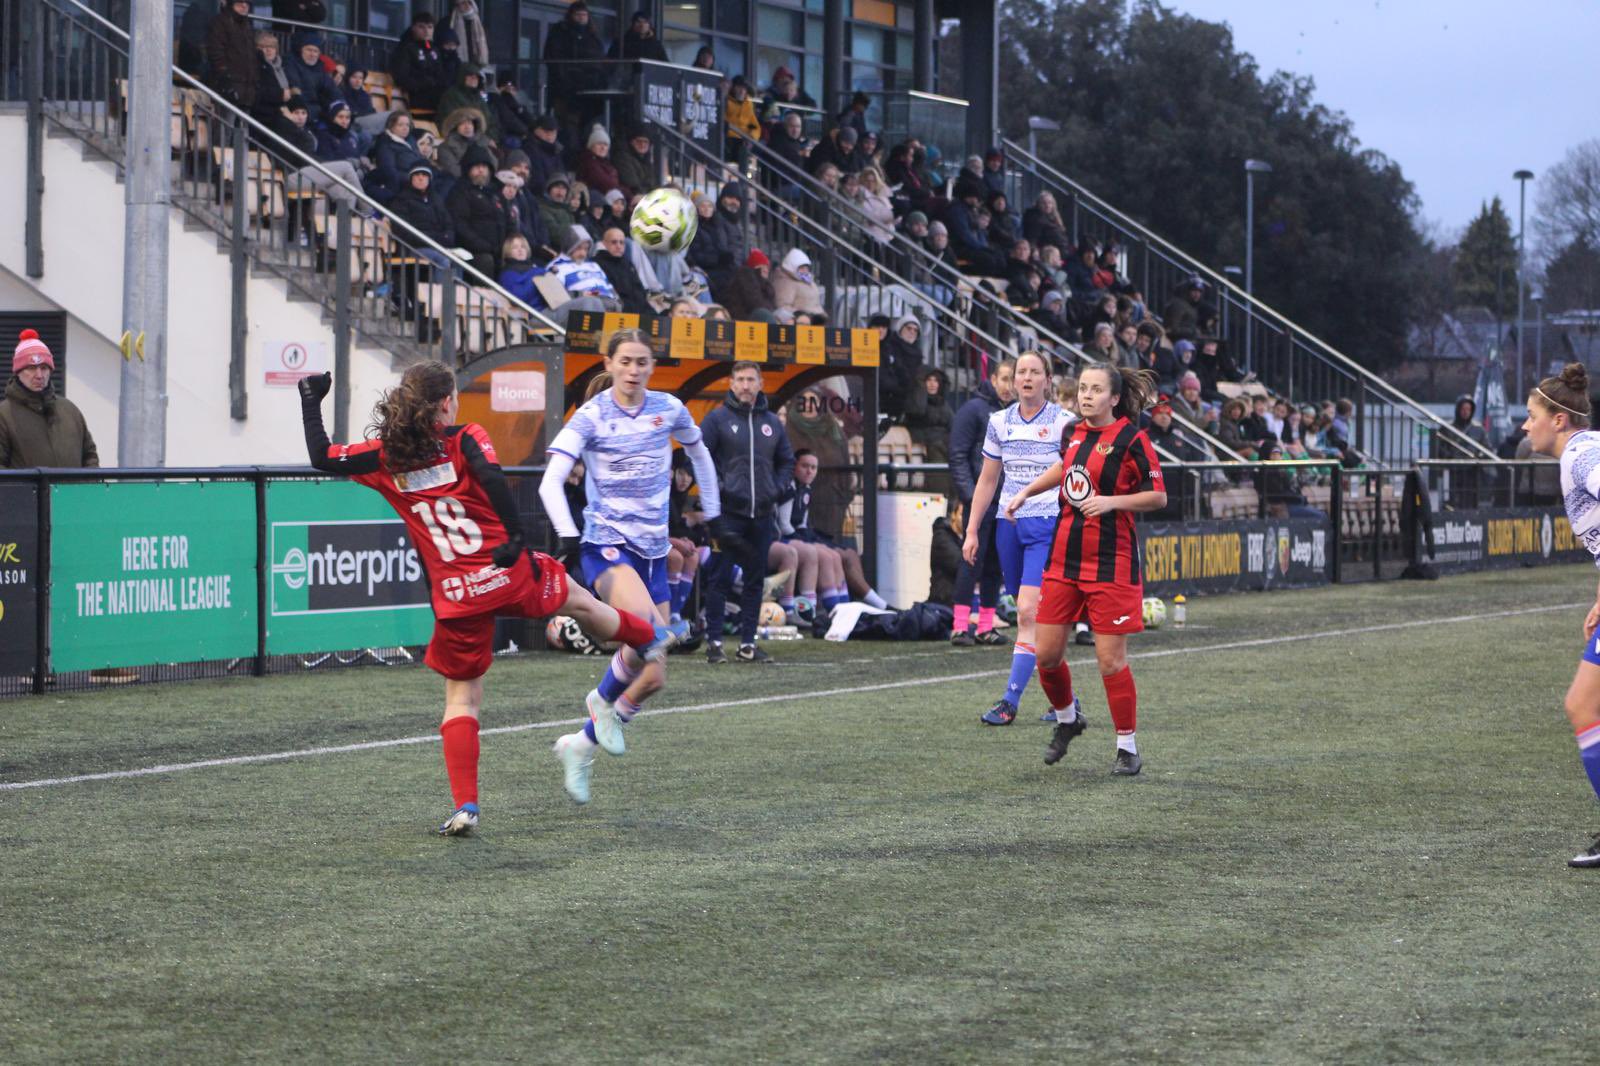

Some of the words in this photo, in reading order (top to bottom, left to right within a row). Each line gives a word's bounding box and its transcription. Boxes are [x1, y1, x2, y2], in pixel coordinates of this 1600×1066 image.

[498, 386, 540, 400] Home
[411, 496, 483, 562] 18
[1445, 521, 1465, 544] Motor
[1465, 520, 1483, 547] Group
[122, 535, 159, 571] HERE
[162, 534, 189, 569] FOR
[283, 535, 425, 597] enterpris
[1145, 535, 1178, 582] SERVE
[1180, 534, 1201, 579] WITH
[1202, 531, 1241, 578] HONOUR
[1291, 535, 1312, 567] Jeep
[76, 581, 104, 617] THE
[108, 578, 177, 613] NATIONAL
[181, 575, 231, 610] LEAGUE
